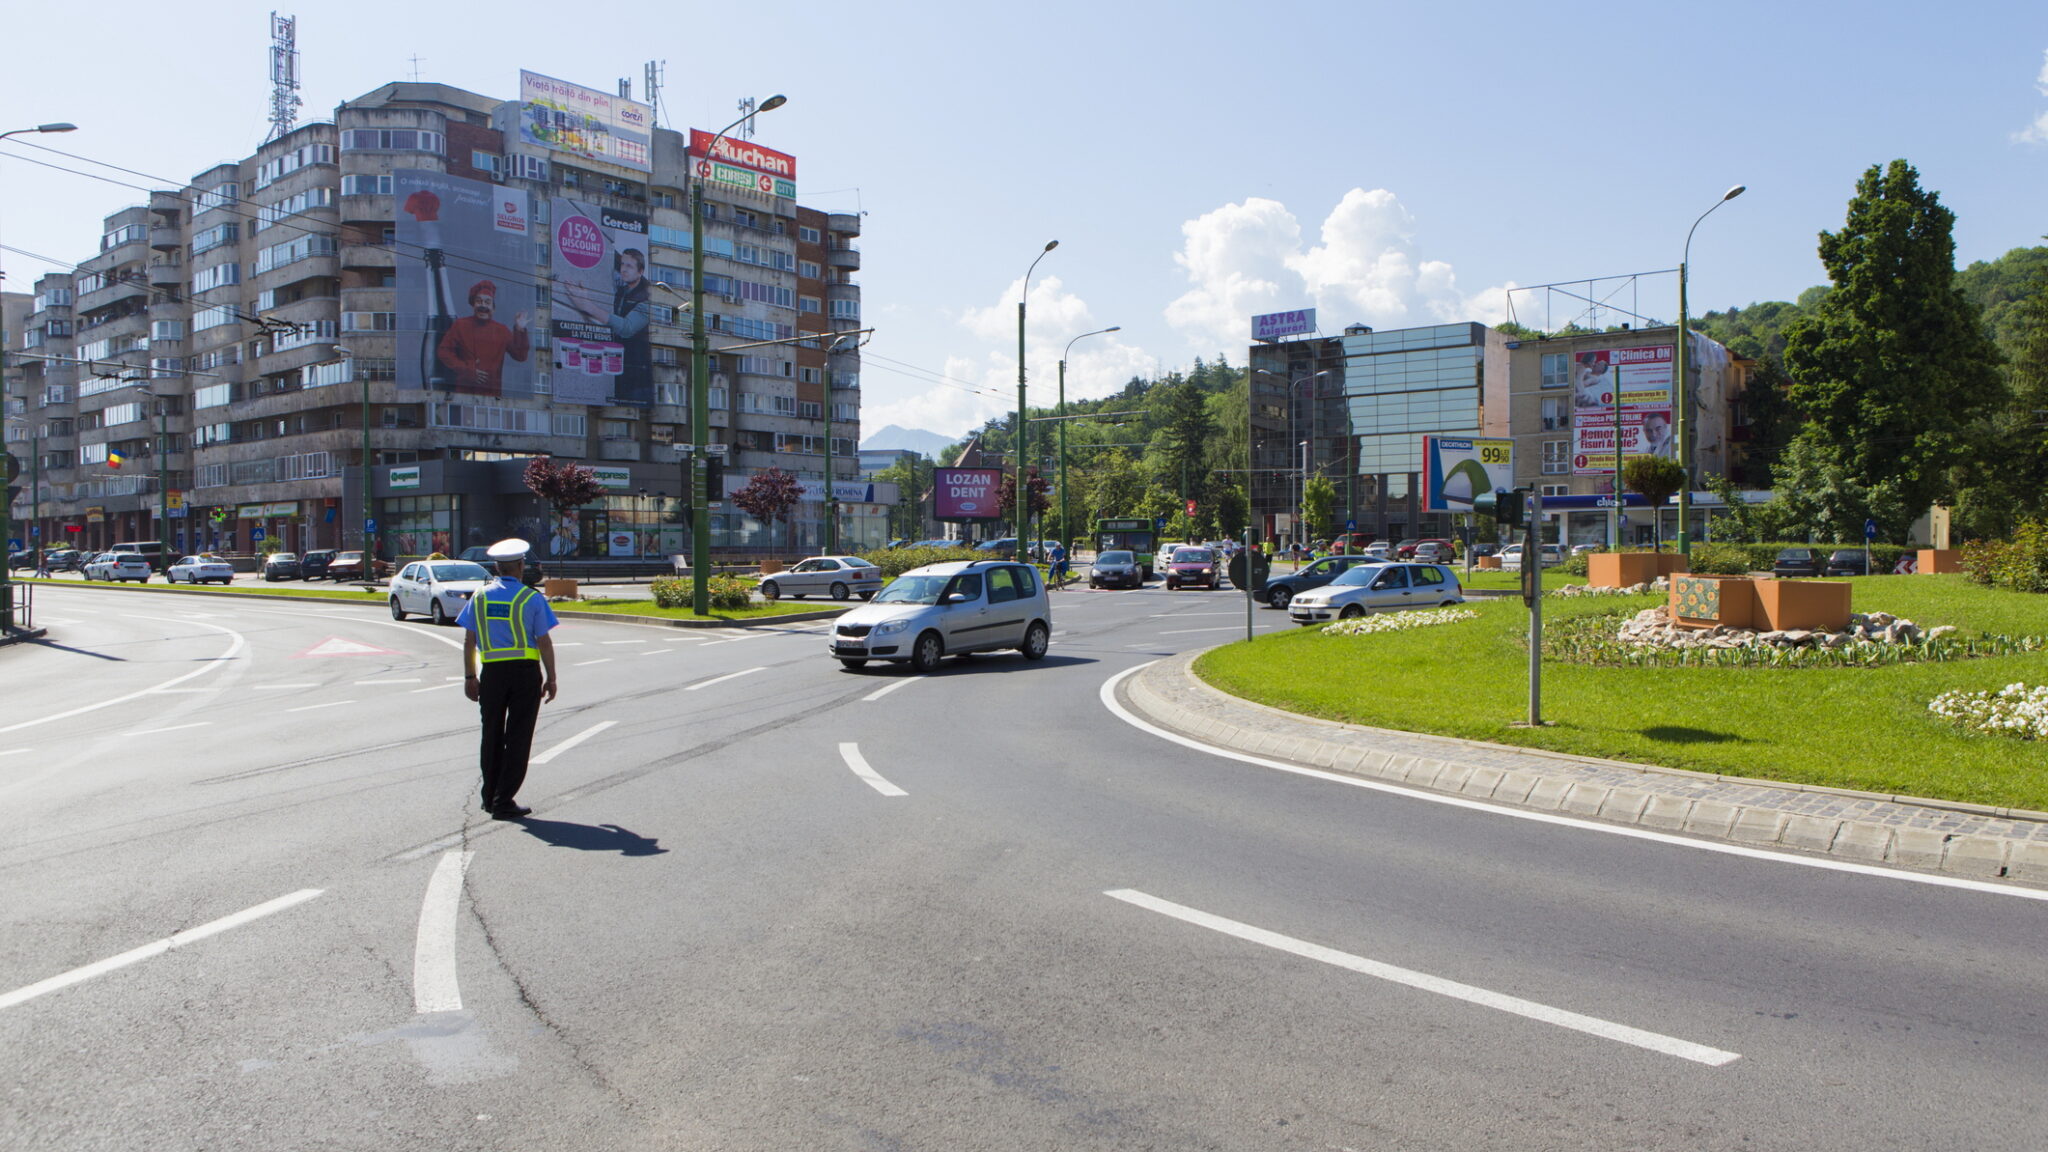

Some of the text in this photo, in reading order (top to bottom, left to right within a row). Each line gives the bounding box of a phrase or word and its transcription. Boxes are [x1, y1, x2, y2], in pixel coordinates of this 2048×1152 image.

[578, 91, 591, 102] din
[593, 96, 609, 107] plin
[621, 109, 643, 122] coresi
[708, 135, 789, 176] Auchan
[716, 167, 795, 197] CORESI CITY
[603, 215, 642, 232] Ceresit
[567, 221, 597, 242] 15%
[562, 237, 601, 253] DISCOUNT
[560, 321, 584, 331] CALITATE
[1259, 311, 1306, 327] ASTRA
[1260, 322, 1307, 336] Asigurari
[1620, 349, 1655, 361] Clinica
[1656, 347, 1671, 359] ON
[1580, 439, 1605, 449] Fisuri
[1482, 447, 1500, 463] 99
[1501, 455, 1510, 463] 90
[592, 471, 628, 481] express
[946, 474, 991, 485] LOZAN
[951, 487, 986, 498] DENT
[367, 519, 374, 528] P
